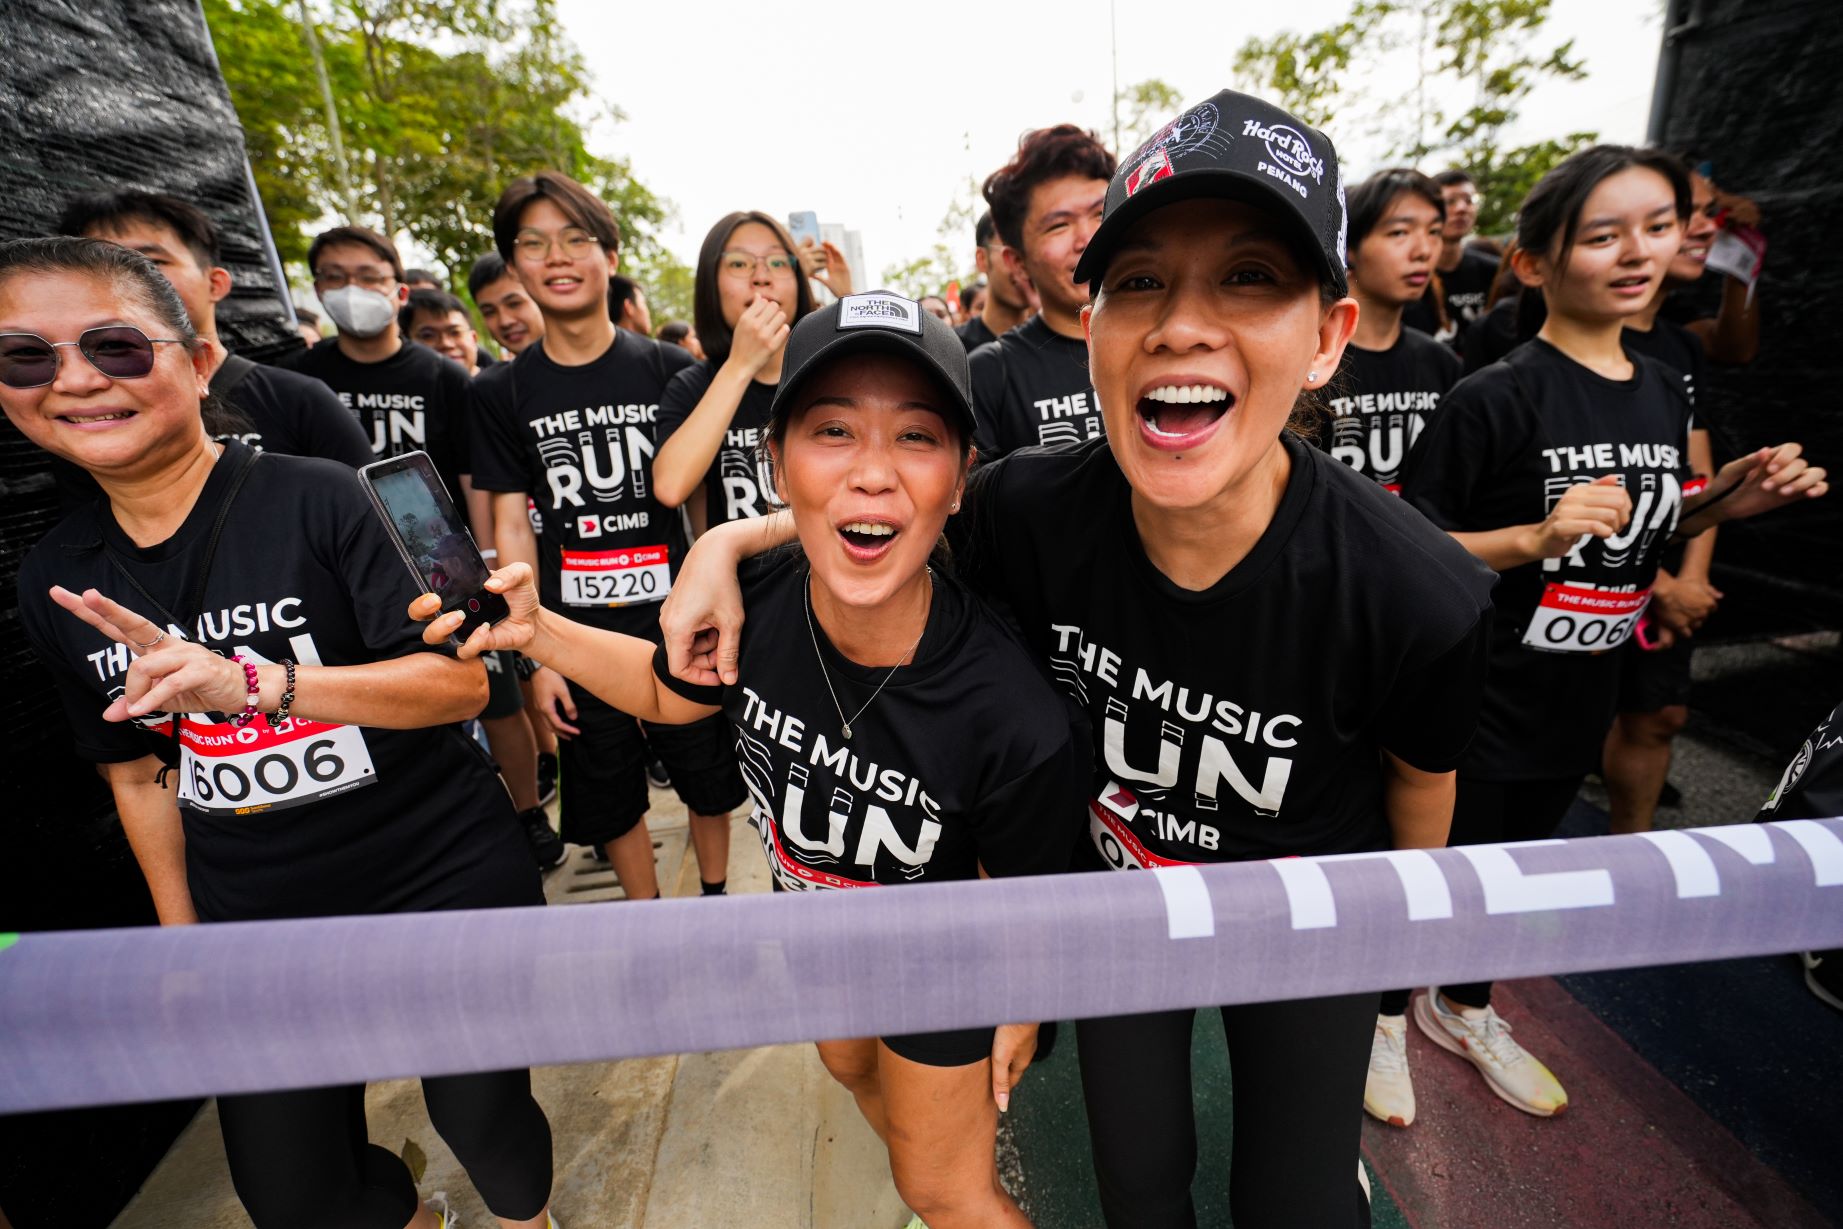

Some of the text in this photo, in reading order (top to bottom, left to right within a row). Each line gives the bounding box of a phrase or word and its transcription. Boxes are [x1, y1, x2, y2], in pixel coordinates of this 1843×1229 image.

[1242, 120, 1324, 185] Hard Rock
[1275, 149, 1303, 172] HOTEL
[1257, 161, 1309, 199] PENANG
[357, 393, 425, 410] MUSIC
[1034, 393, 1089, 421] THE
[1329, 396, 1376, 417] THE
[371, 411, 426, 454] UN
[529, 404, 660, 438] THE MUSIC
[726, 428, 760, 448] HE
[541, 426, 657, 509] RUN
[1542, 443, 1616, 473] THE
[603, 511, 650, 532] CIMB
[573, 570, 656, 599] 15220
[1557, 593, 1581, 605] THE
[1581, 597, 1615, 609] MUSIC
[87, 642, 139, 682] TH
[1051, 624, 1303, 748] THE MUSIC
[743, 686, 942, 823] THE MUSIC
[1090, 697, 1293, 816] UN
[755, 775, 943, 866] UN
